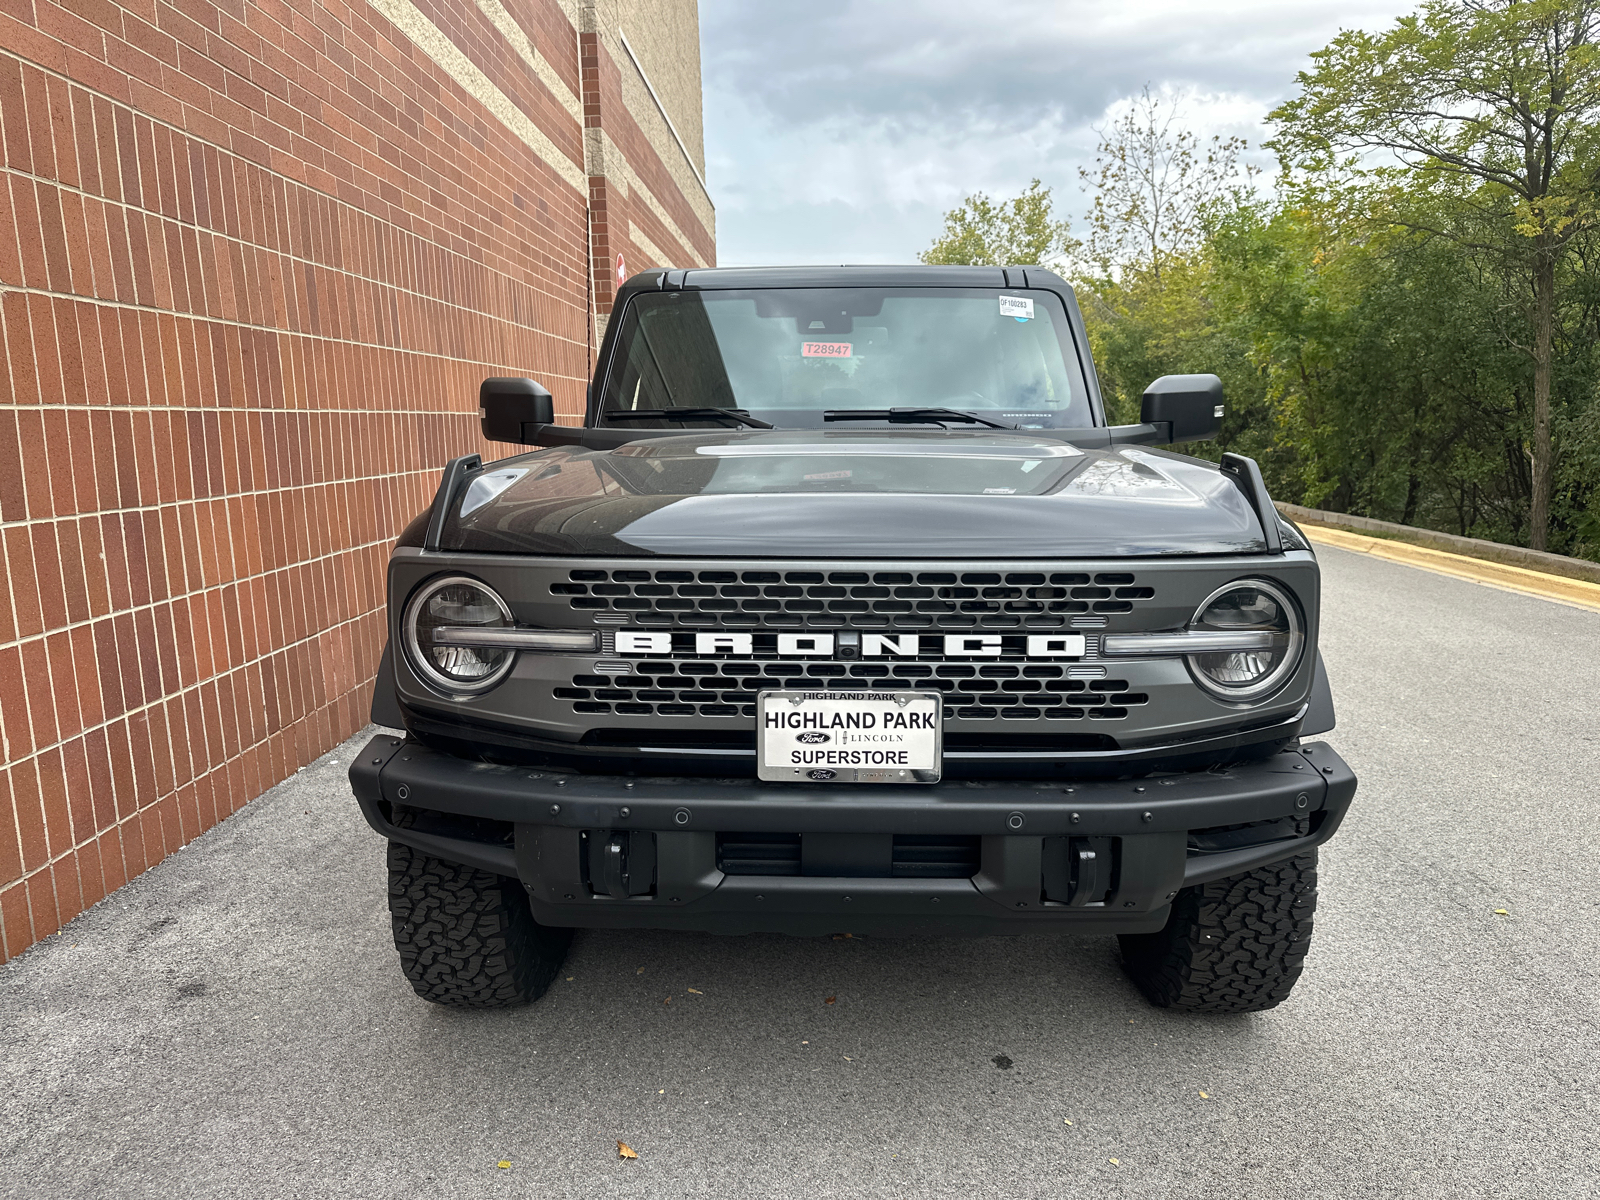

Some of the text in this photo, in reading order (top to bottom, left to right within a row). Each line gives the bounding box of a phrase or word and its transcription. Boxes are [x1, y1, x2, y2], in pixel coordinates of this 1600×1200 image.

[805, 343, 850, 355] T28947
[615, 631, 1086, 657] BRONCO
[803, 692, 897, 701] HIGHLAND PARK
[765, 711, 936, 729] HIGHLAND PARK
[851, 734, 904, 742] LINCOLN
[791, 750, 909, 764] SUPERSTORE
